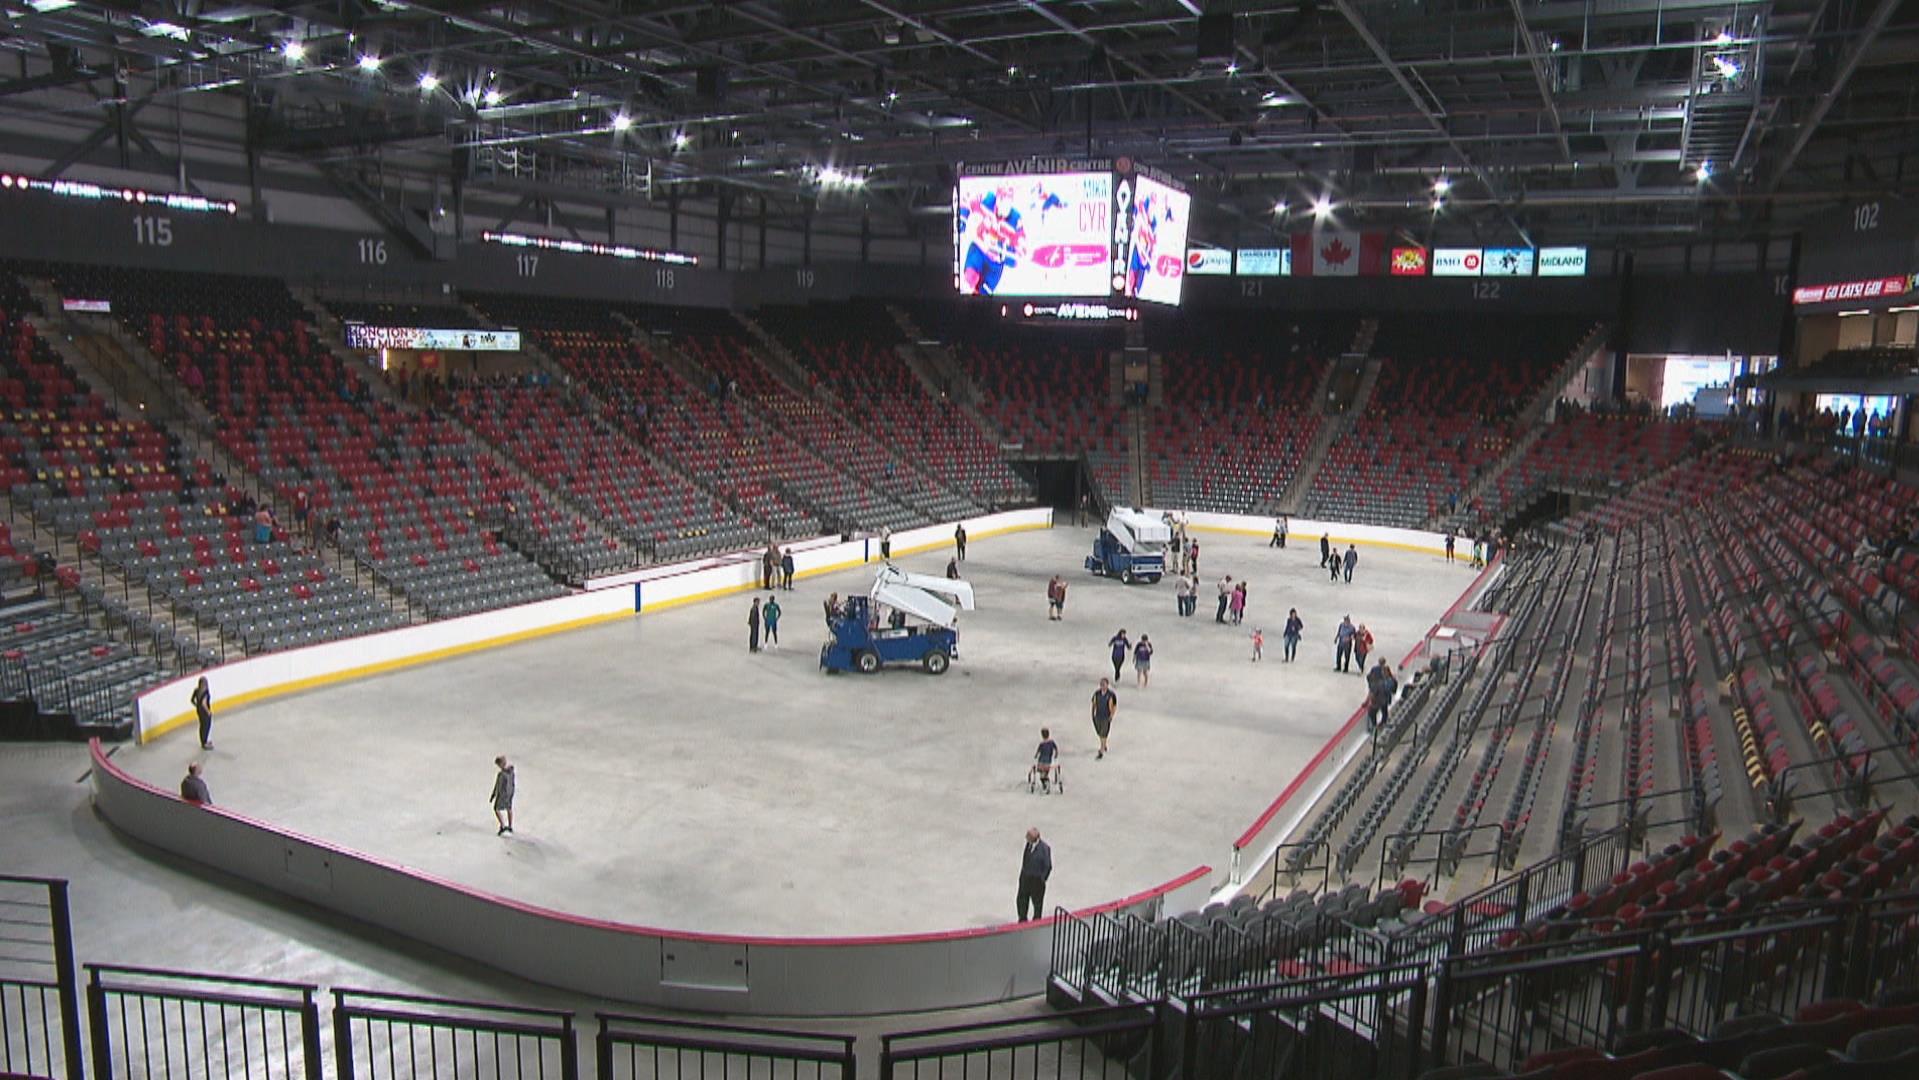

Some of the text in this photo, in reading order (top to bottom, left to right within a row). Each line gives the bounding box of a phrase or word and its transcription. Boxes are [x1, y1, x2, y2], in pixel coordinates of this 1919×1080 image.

[1005, 158, 1068, 174] AVENIR
[1079, 202, 1106, 232] CYR
[1854, 202, 1880, 231] 102
[133, 216, 173, 246] 115
[358, 239, 388, 265] 116
[1540, 255, 1585, 267] MIDLAND
[515, 254, 538, 277] 117
[656, 268, 674, 288] 118
[796, 270, 814, 288] 119
[1240, 279, 1263, 297] 121
[1472, 281, 1501, 299] 122
[1057, 303, 1109, 319] AVENIR
[378, 337, 414, 350] MUSIC
